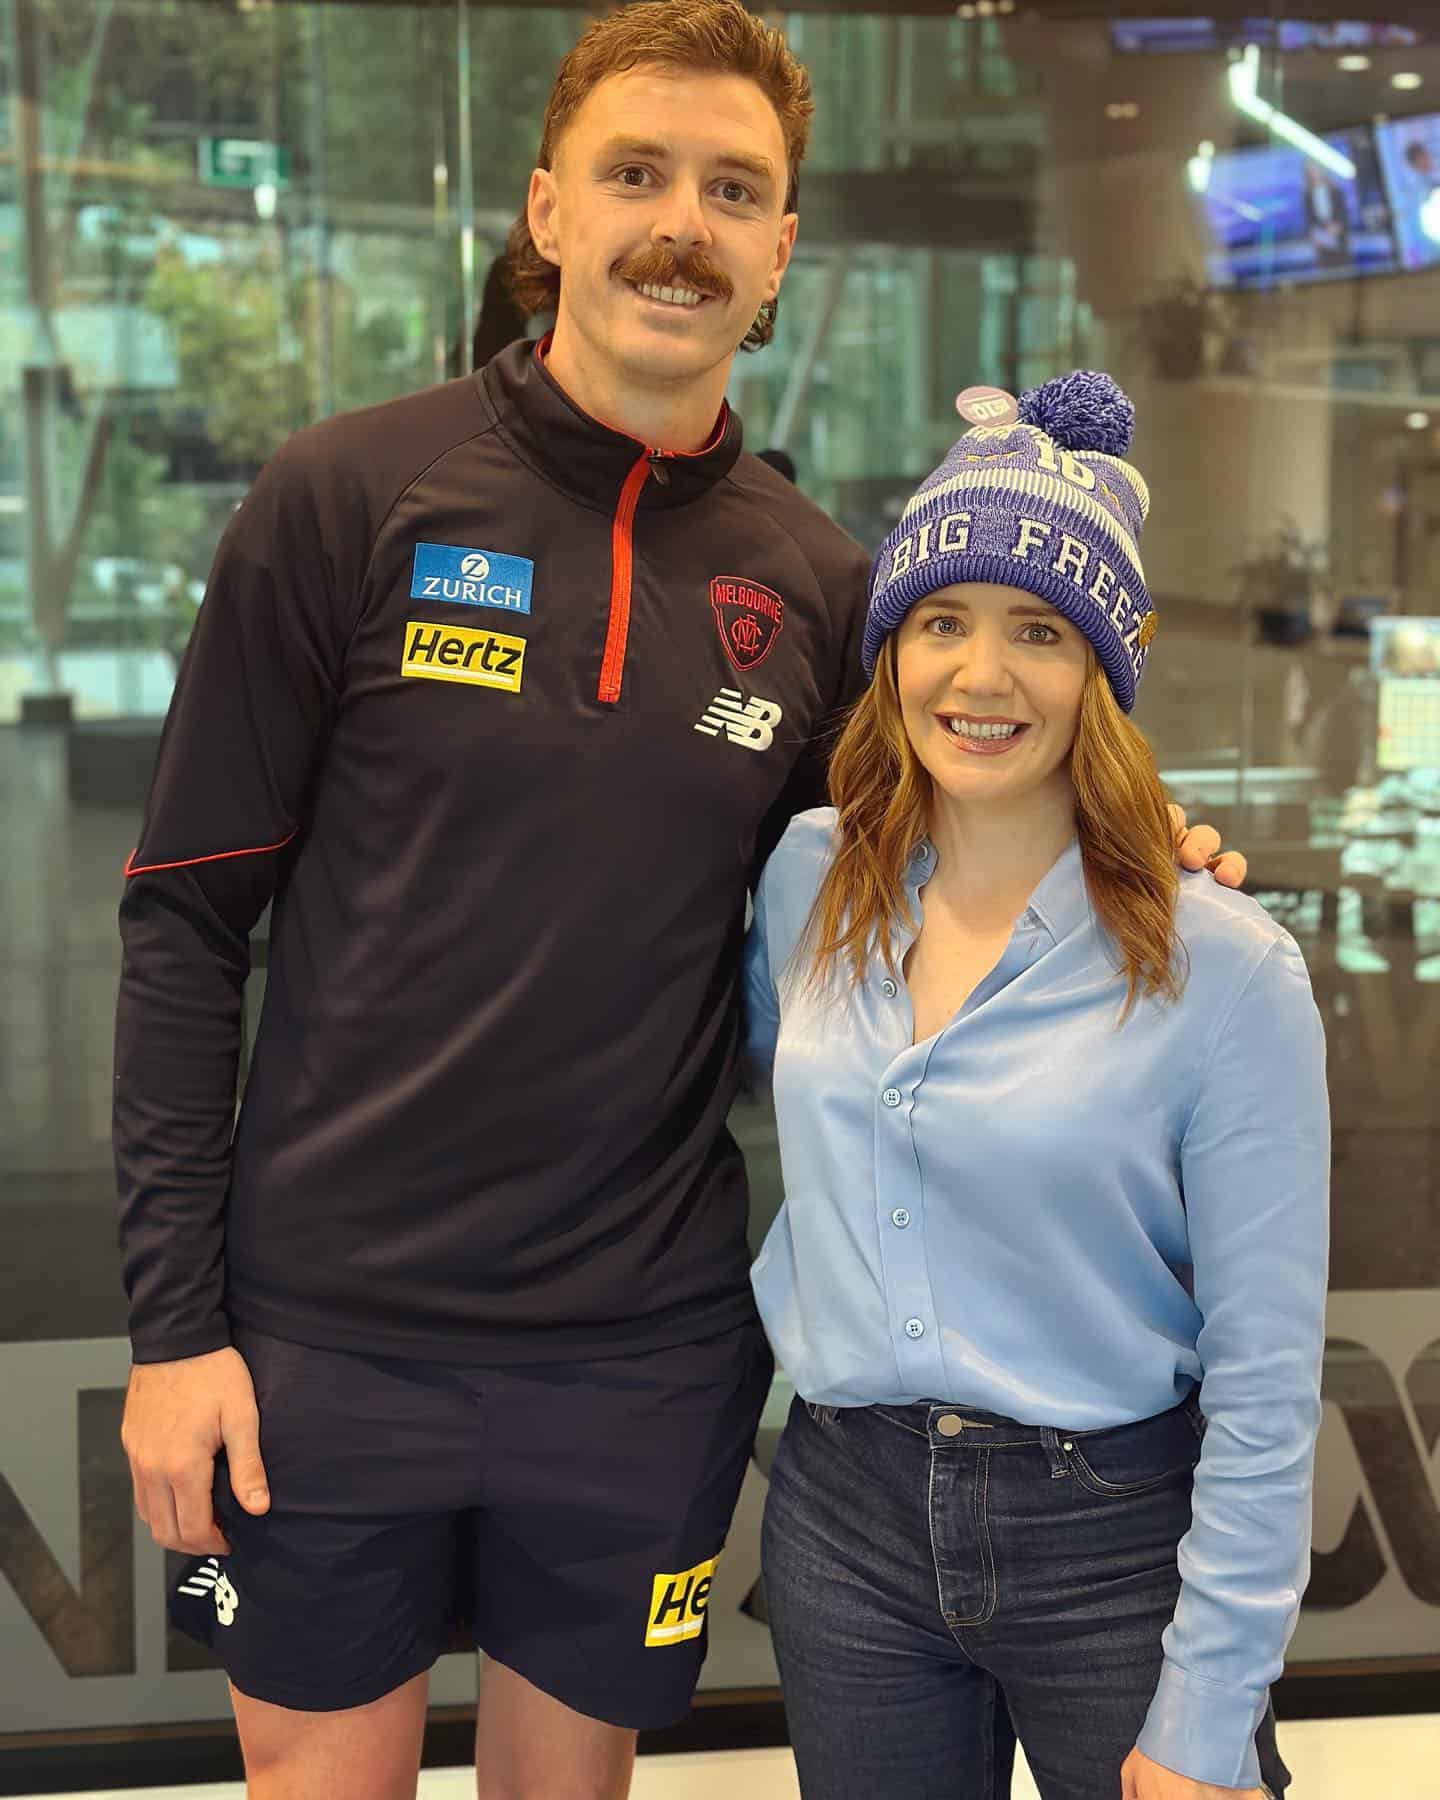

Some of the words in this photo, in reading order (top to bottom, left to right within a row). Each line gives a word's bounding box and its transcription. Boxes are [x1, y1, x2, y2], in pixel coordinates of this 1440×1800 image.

[887, 511, 972, 583] BIG
[421, 576, 522, 609] ZURICH
[715, 583, 782, 624] MELBOURNE
[407, 628, 522, 676] Hertz
